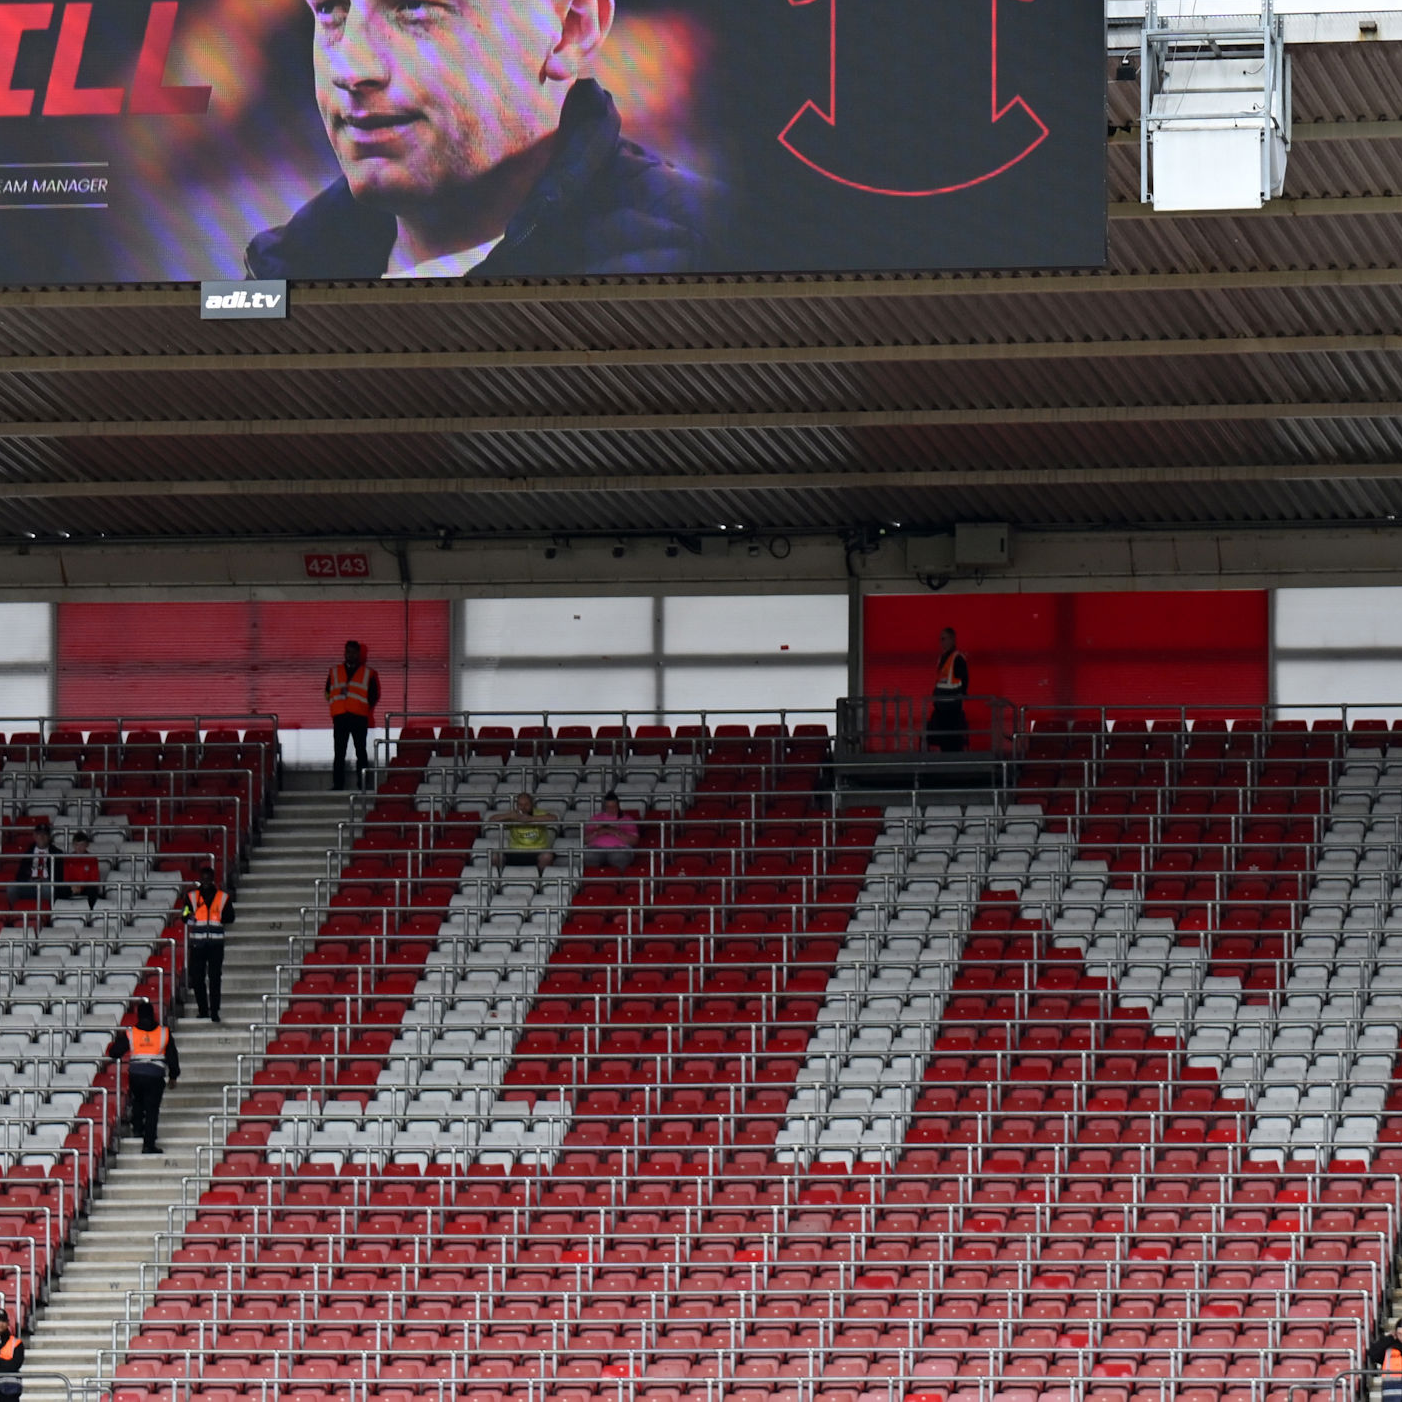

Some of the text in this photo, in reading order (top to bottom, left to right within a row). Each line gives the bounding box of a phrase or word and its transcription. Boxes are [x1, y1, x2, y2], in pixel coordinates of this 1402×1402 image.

[31, 177, 109, 194] MANAGER
[205, 290, 281, 309] adi.tv
[308, 557, 366, 574] 42 43
